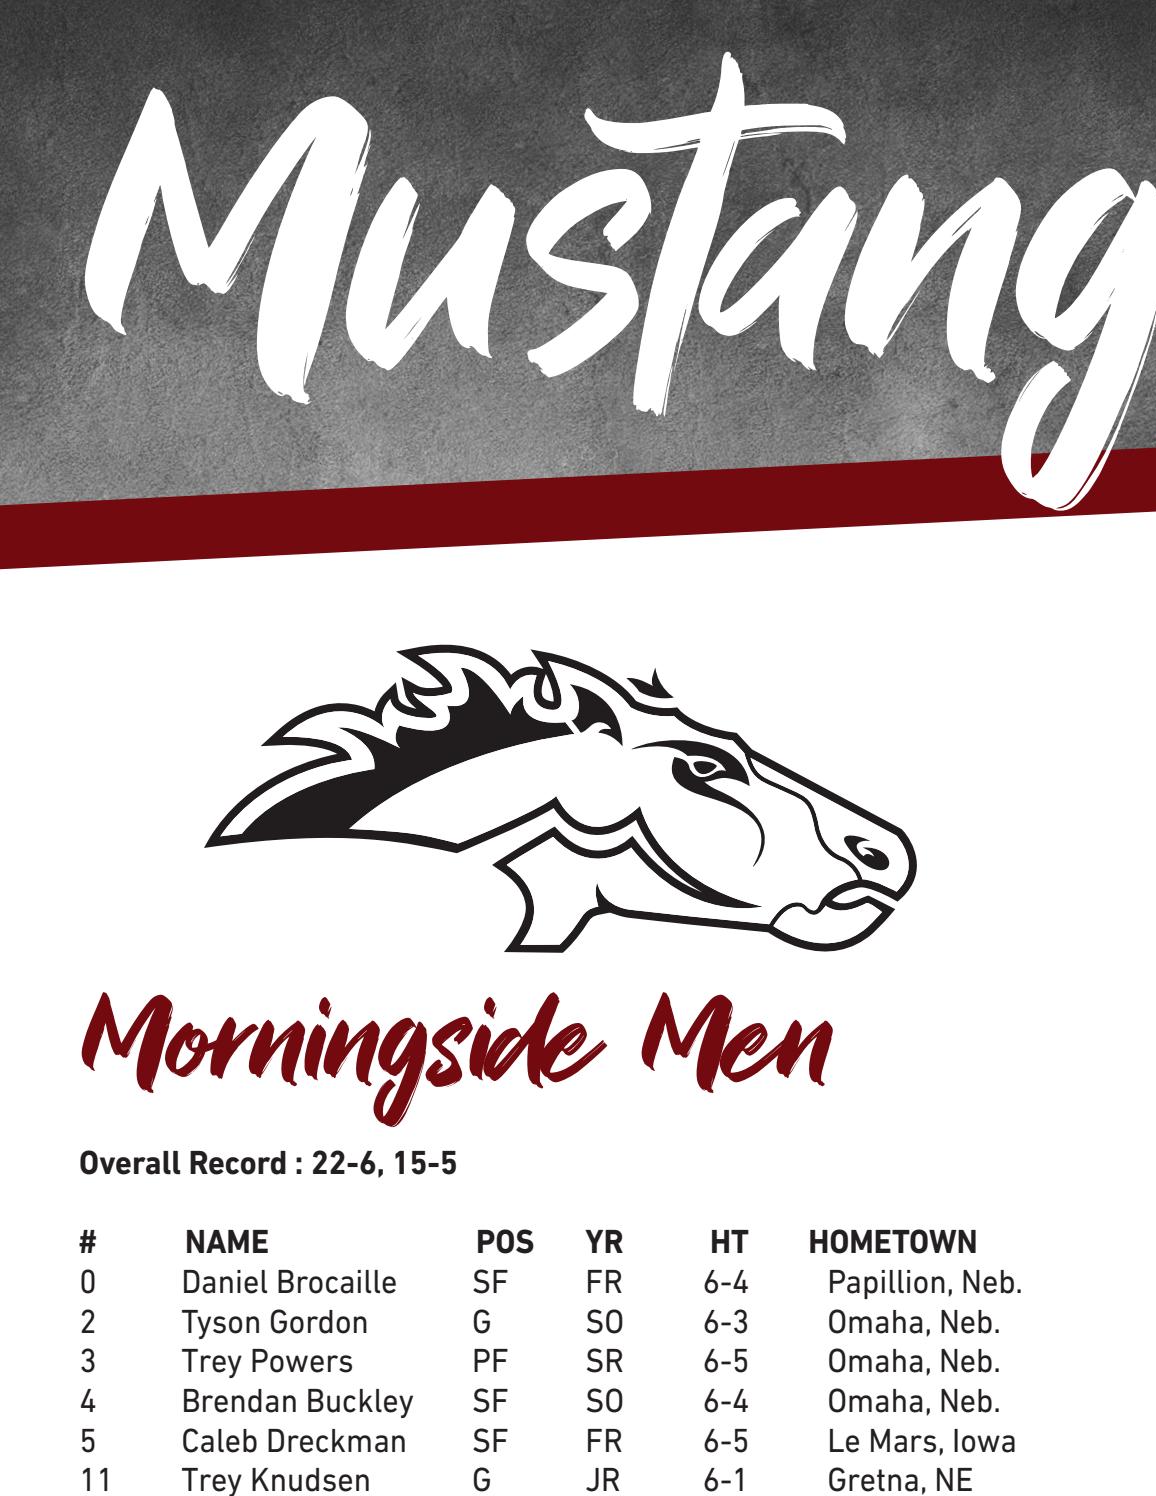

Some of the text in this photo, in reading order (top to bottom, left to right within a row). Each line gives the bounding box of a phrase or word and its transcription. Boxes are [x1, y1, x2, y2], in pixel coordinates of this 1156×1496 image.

[81, 991, 834, 1128] Morningside Men
[79, 1149, 181, 1175] Overall
[190, 1150, 286, 1175] Record
[312, 1149, 384, 1178] 22-6,
[394, 1150, 457, 1175] 15-5
[186, 1229, 269, 1254] NAME
[477, 1228, 534, 1254] POS
[585, 1229, 623, 1254] YR
[711, 1229, 749, 1254] HT
[809, 1228, 977, 1254] HOMETOWN
[80, 1269, 1022, 1300] 0 Daniel Brocaille SF FR 6-4 Papillion, Neb.
[81, 1308, 1000, 1340] 2 Tyson Gordon G SO 6-3 Omaha, Neb.
[80, 1387, 1000, 1419] 4 Brendan Buckley SF SO 6-4 Omaha, Neb.
[81, 1427, 1016, 1456] 5 Caleb Dreckman SF FR 6-5 Le Mars, Iowa
[82, 1467, 108, 1492] 11
[252, 1467, 370, 1492] Knudsen
[473, 1467, 491, 1492] G
[586, 1467, 620, 1492] JR
[704, 1467, 744, 1492] 6-1
[828, 1466, 926, 1495] Gretna,
[936, 1467, 973, 1492] NE
